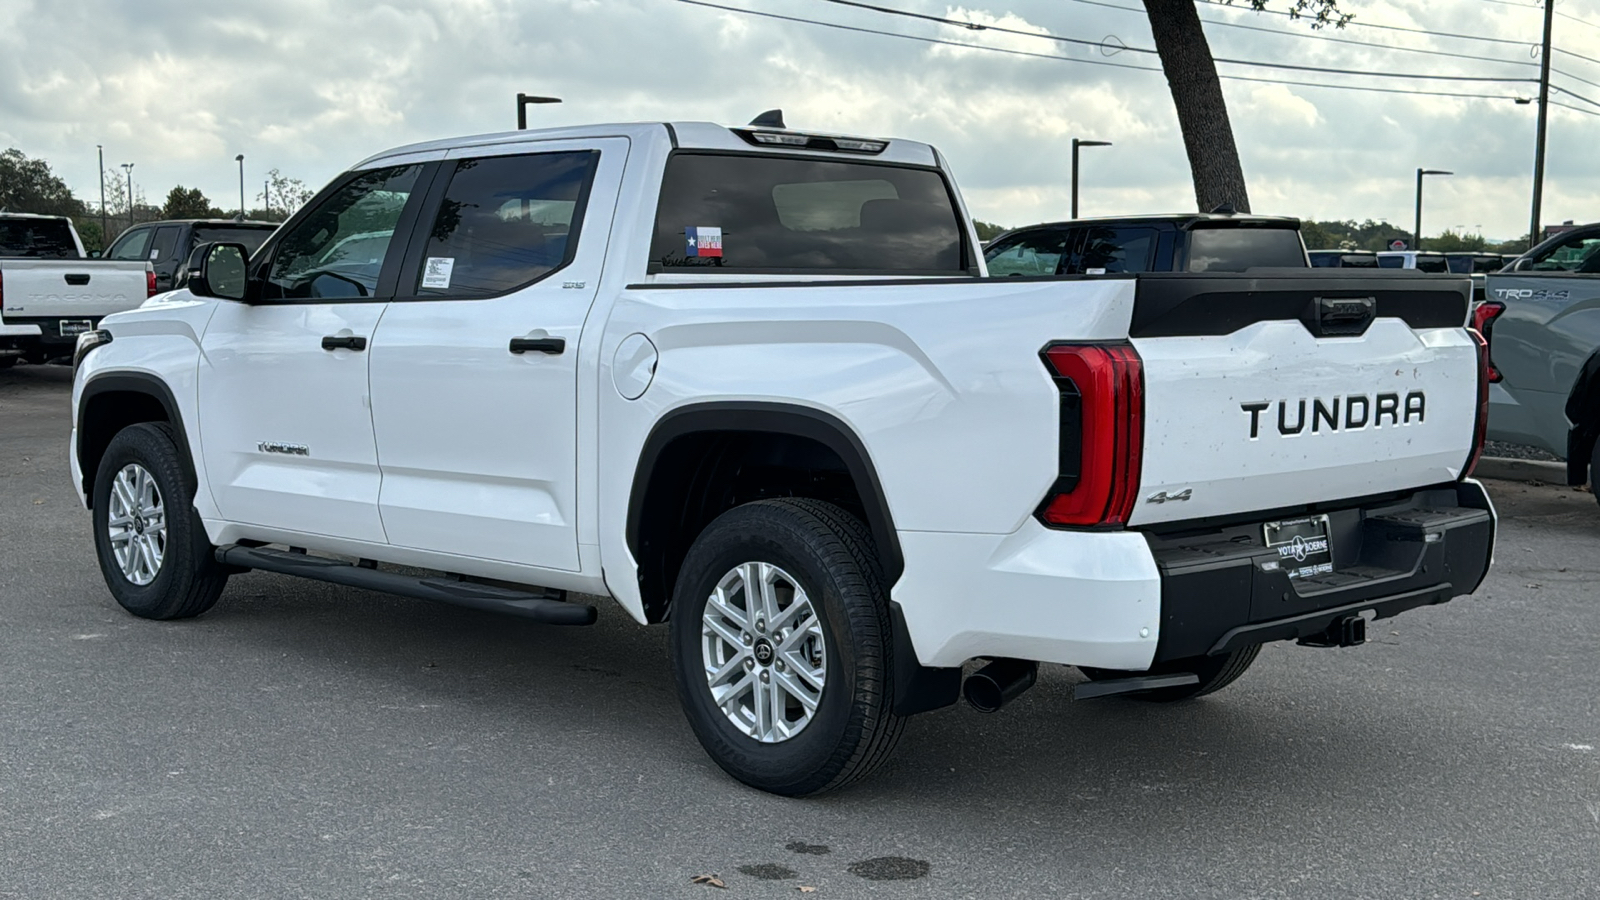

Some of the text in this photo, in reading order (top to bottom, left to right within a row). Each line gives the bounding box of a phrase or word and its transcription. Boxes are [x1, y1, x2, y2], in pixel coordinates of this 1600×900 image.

[1495, 289, 1533, 299] TRD
[1240, 389, 1426, 441] TUNDRA
[256, 440, 309, 456] TUNDRA
[1305, 540, 1328, 552] BOERNE
